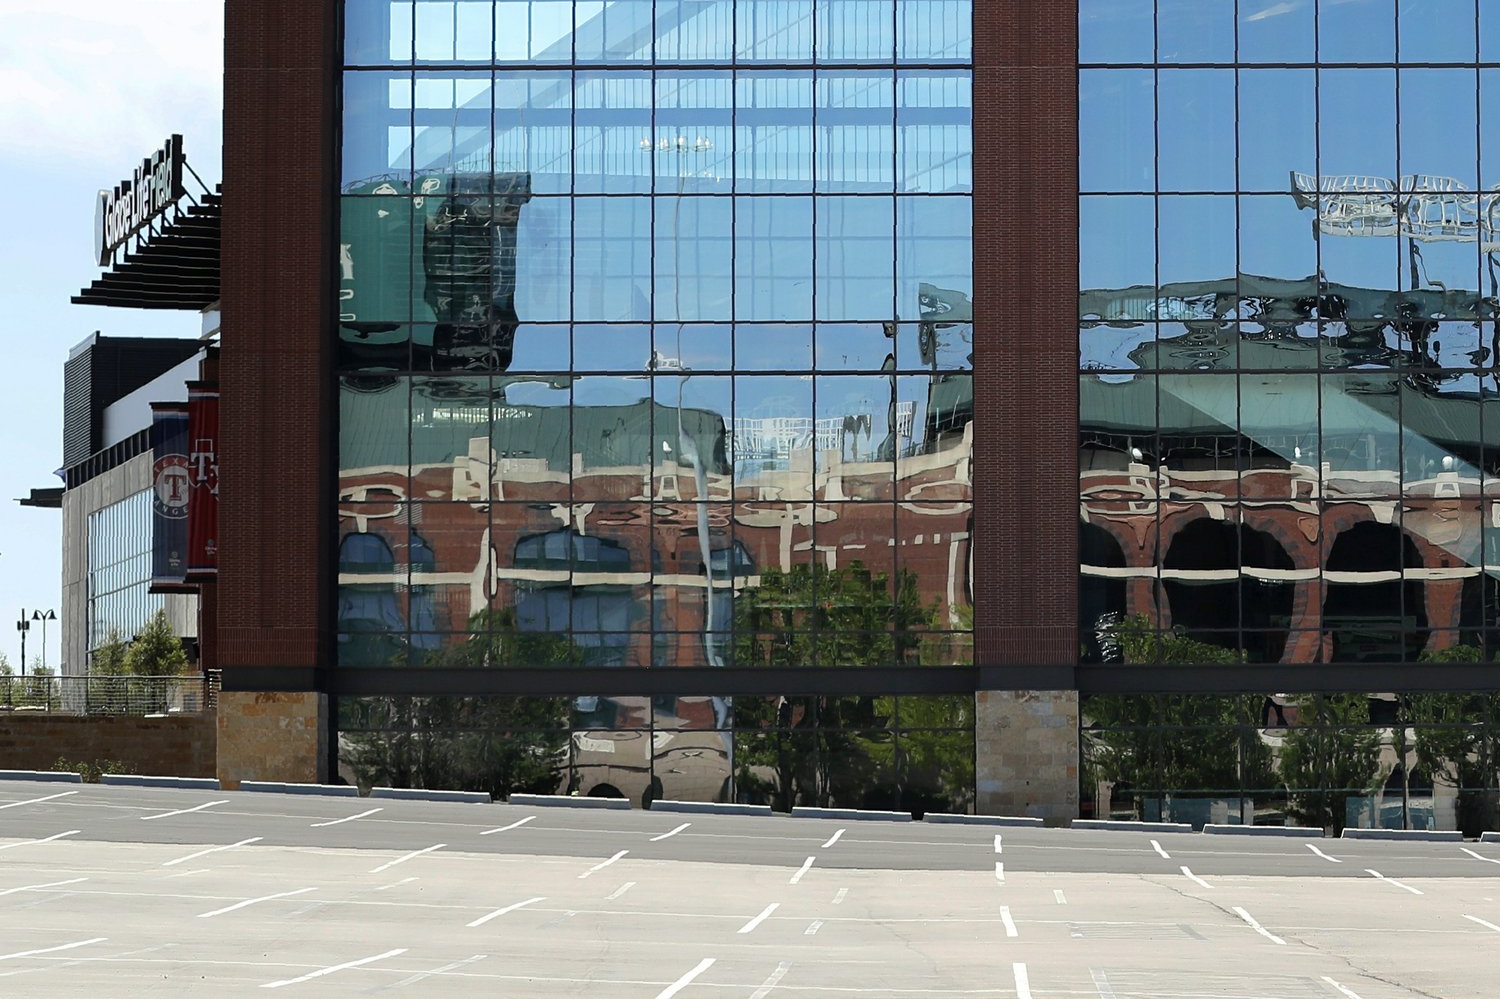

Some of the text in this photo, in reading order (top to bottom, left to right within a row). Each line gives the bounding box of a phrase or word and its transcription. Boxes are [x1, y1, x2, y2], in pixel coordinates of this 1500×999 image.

[105, 181, 133, 249] Globe
[132, 159, 152, 229] Life
[154, 457, 188, 473] TEXA
